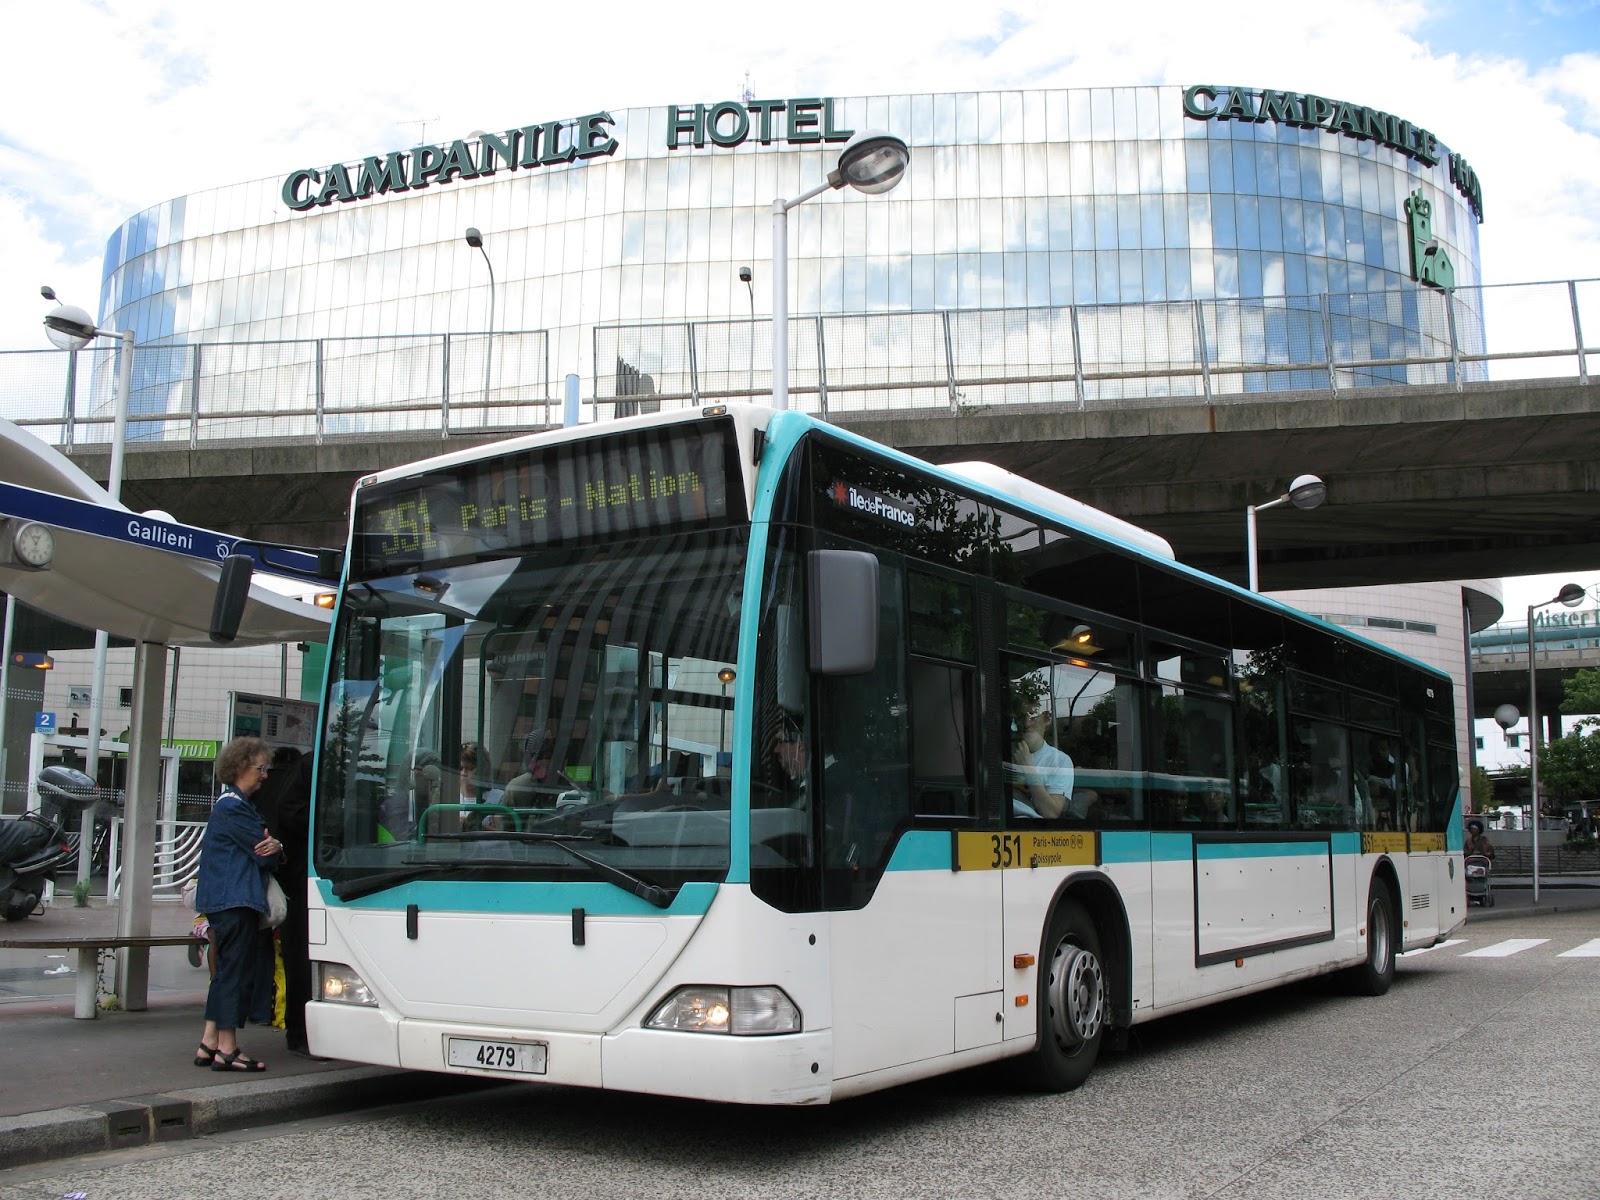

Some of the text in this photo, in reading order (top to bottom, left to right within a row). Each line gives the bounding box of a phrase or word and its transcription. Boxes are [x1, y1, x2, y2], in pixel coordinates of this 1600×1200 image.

[1184, 85, 1440, 168] CAMPANILE
[282, 97, 855, 211] CAMPANILE HOTEL
[379, 499, 437, 555] 351
[461, 495, 547, 531] Paris
[585, 471, 699, 510] Nation
[127, 520, 193, 550] Gallieni
[40, 714, 50, 726] 2
[991, 834, 1021, 868] 351
[1033, 837, 1047, 847] Paris
[1051, 836, 1069, 847] Nation
[476, 1045, 515, 1067] 4279
